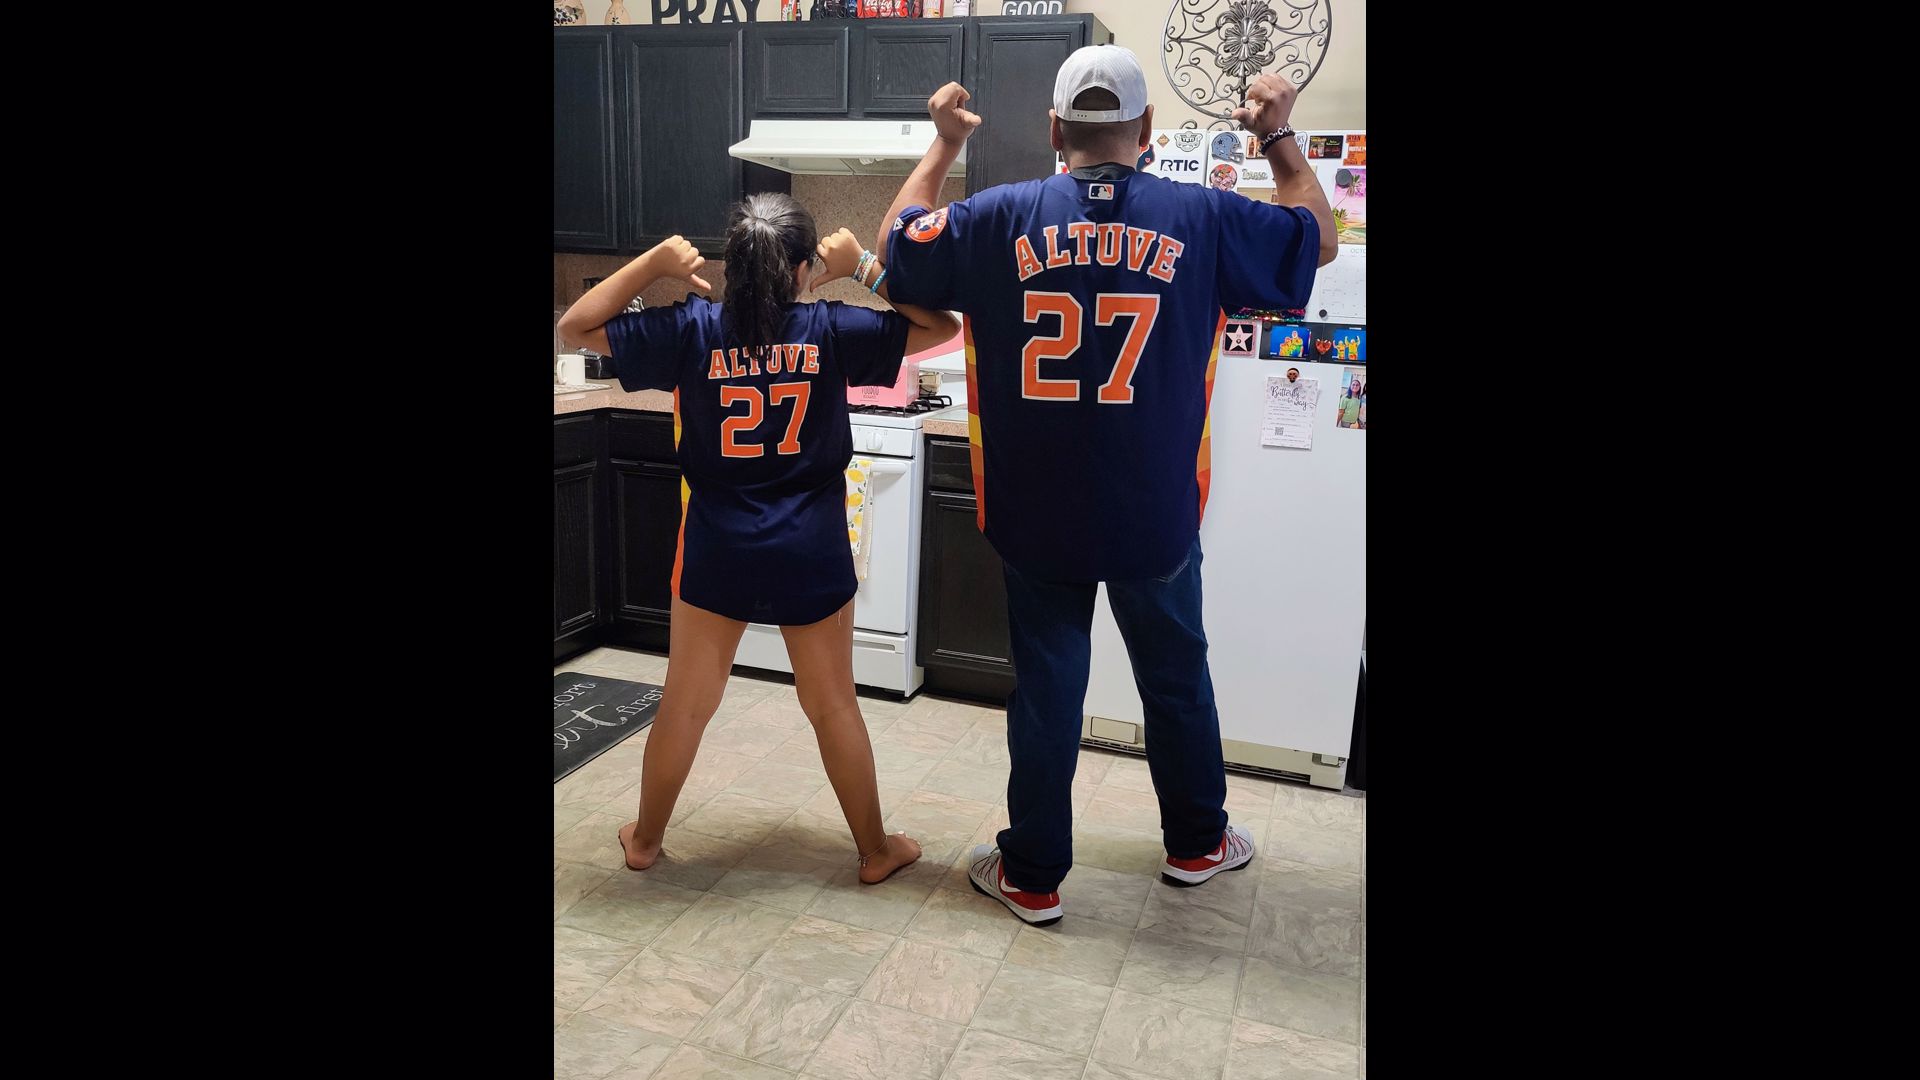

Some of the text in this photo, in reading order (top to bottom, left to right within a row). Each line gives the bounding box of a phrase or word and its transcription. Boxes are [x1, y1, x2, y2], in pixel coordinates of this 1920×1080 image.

[651, 0, 761, 24] PRAY
[1002, 0, 1063, 16] GOOD
[1160, 159, 1199, 172] RTIC
[1015, 221, 1185, 284] ALTUVE
[1021, 290, 1161, 404] 27
[720, 381, 811, 459] 27
[616, 688, 664, 716] first
